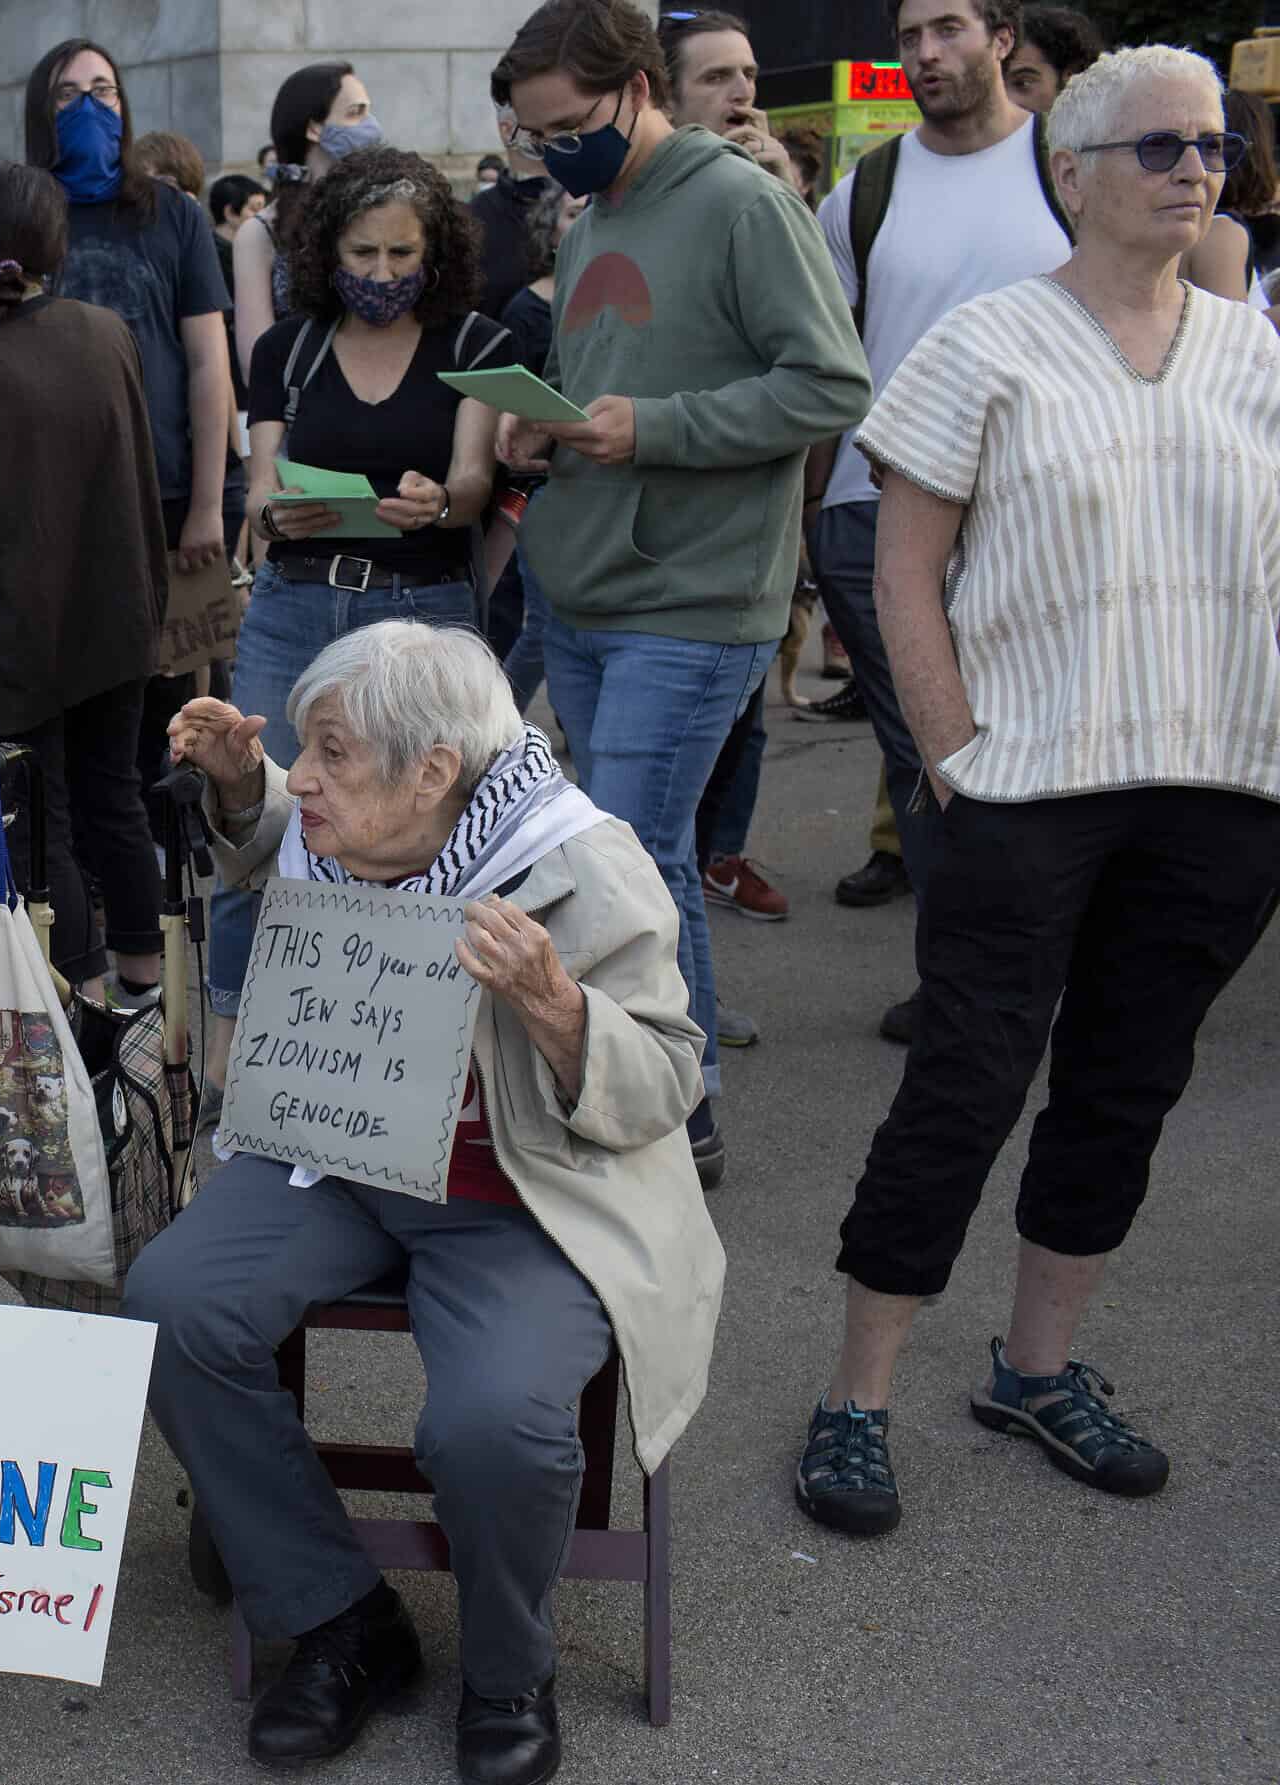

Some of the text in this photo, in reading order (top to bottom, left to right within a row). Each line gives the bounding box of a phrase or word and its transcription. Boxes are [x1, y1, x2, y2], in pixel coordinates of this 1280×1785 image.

[266, 924, 462, 994] THIS 90 year old
[288, 986, 403, 1045] JEW SAYS
[246, 1033, 405, 1082] ZIONISM IS
[270, 1091, 388, 1137] GENOCIDE
